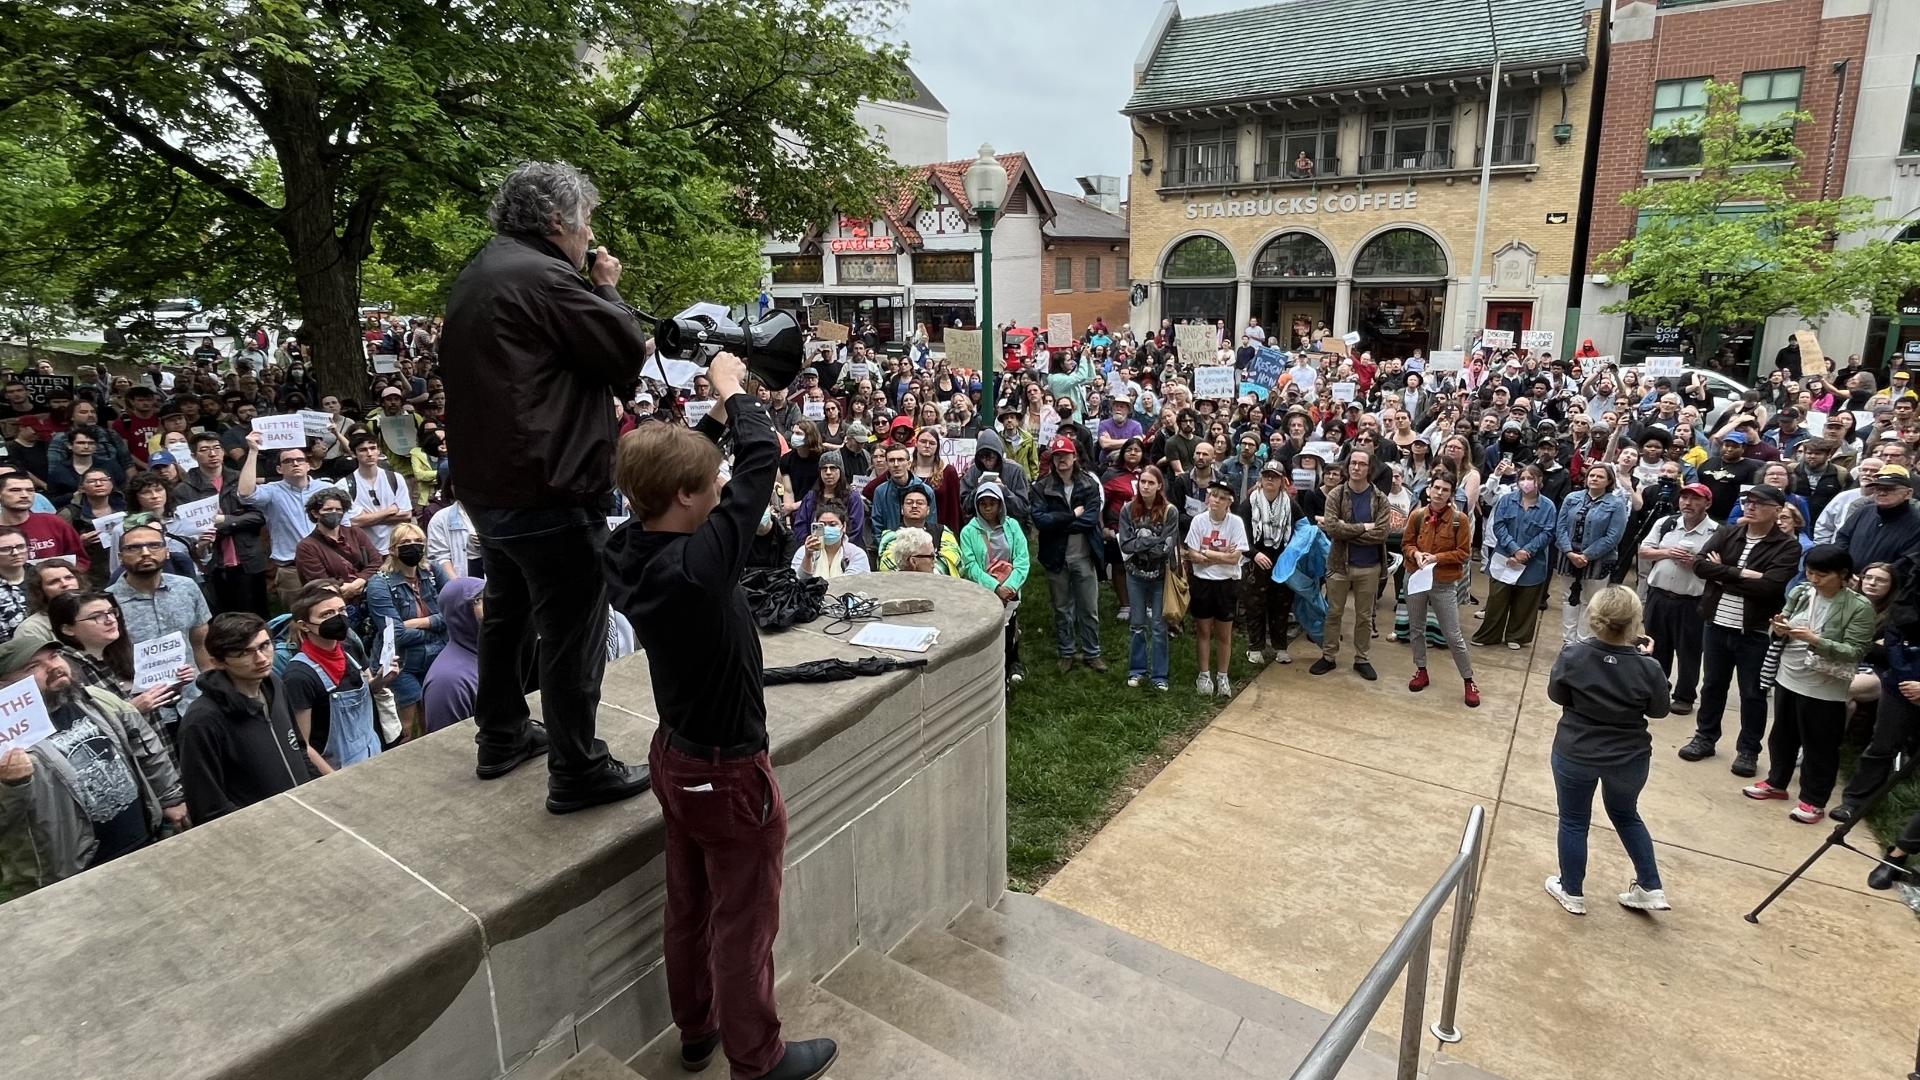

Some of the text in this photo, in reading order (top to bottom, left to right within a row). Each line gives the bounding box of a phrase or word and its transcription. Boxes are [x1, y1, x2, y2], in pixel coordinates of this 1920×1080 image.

[1186, 191, 1418, 219] STARBUCKS COFFEE
[831, 239, 892, 251] GABLES
[259, 422, 278, 430] LIFT
[280, 421, 299, 429] THE
[267, 433, 294, 441] BANS
[185, 507, 204, 518] LIFT
[195, 517, 215, 528] BAN
[29, 539, 55, 551] SIERS
[0, 692, 34, 717] THE
[0, 719, 30, 743] ANS
